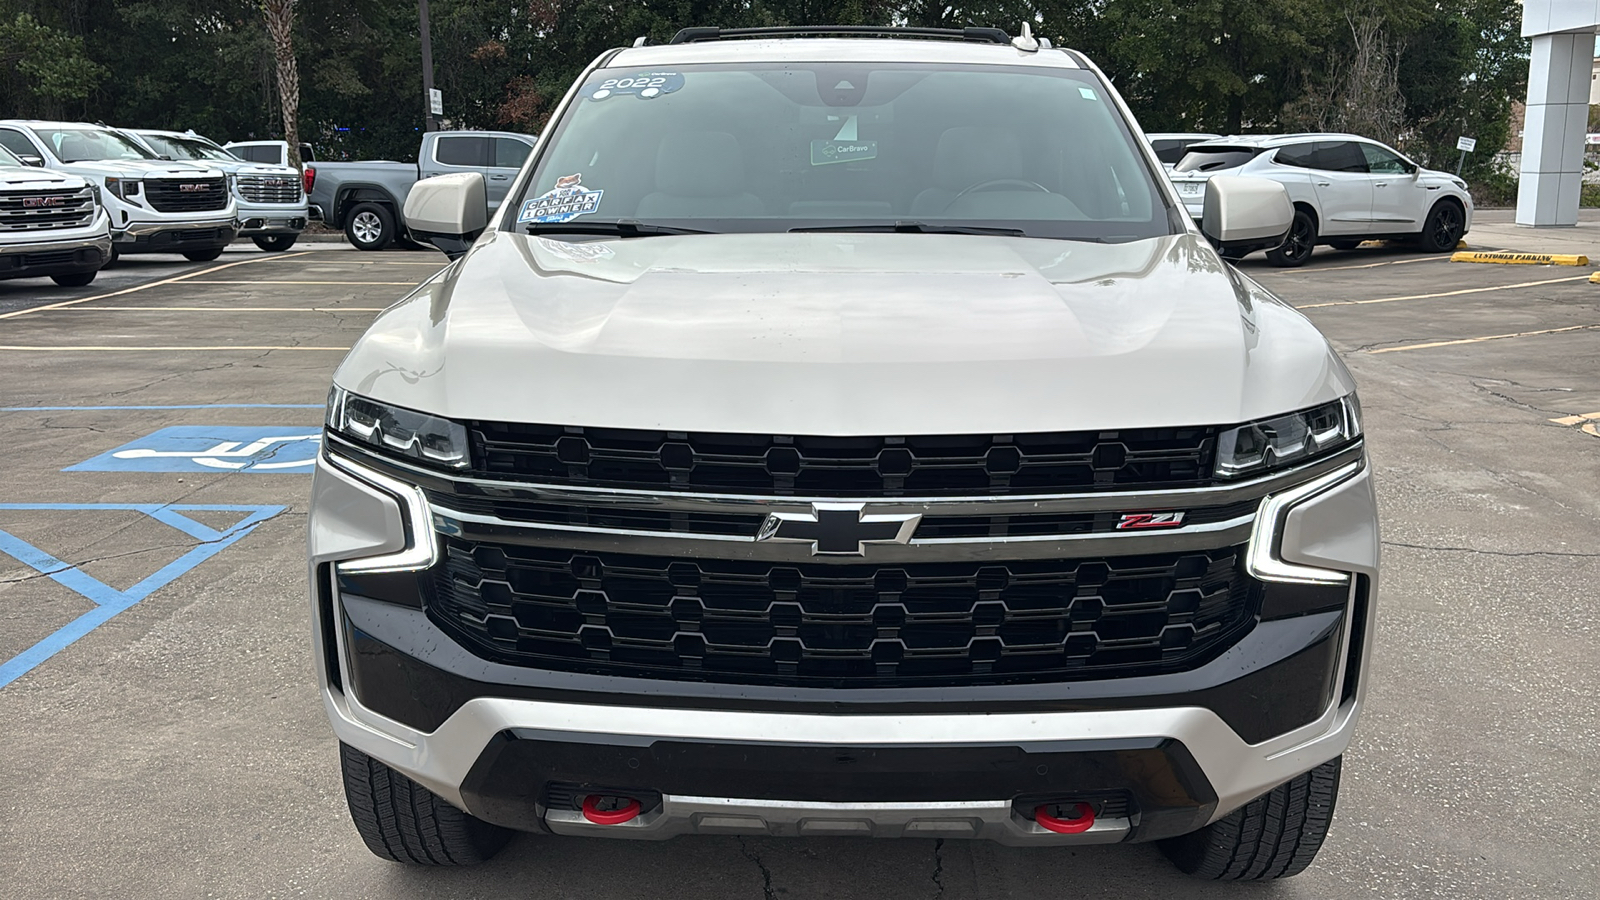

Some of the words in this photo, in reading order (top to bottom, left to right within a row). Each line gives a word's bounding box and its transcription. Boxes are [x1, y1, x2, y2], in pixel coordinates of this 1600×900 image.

[599, 77, 667, 90] 2022
[837, 145, 869, 153] CarBravo
[22, 196, 66, 208] GMC
[527, 195, 597, 210] CARFAX
[535, 202, 595, 217] OWNER
[1515, 254, 1552, 262] PARKING
